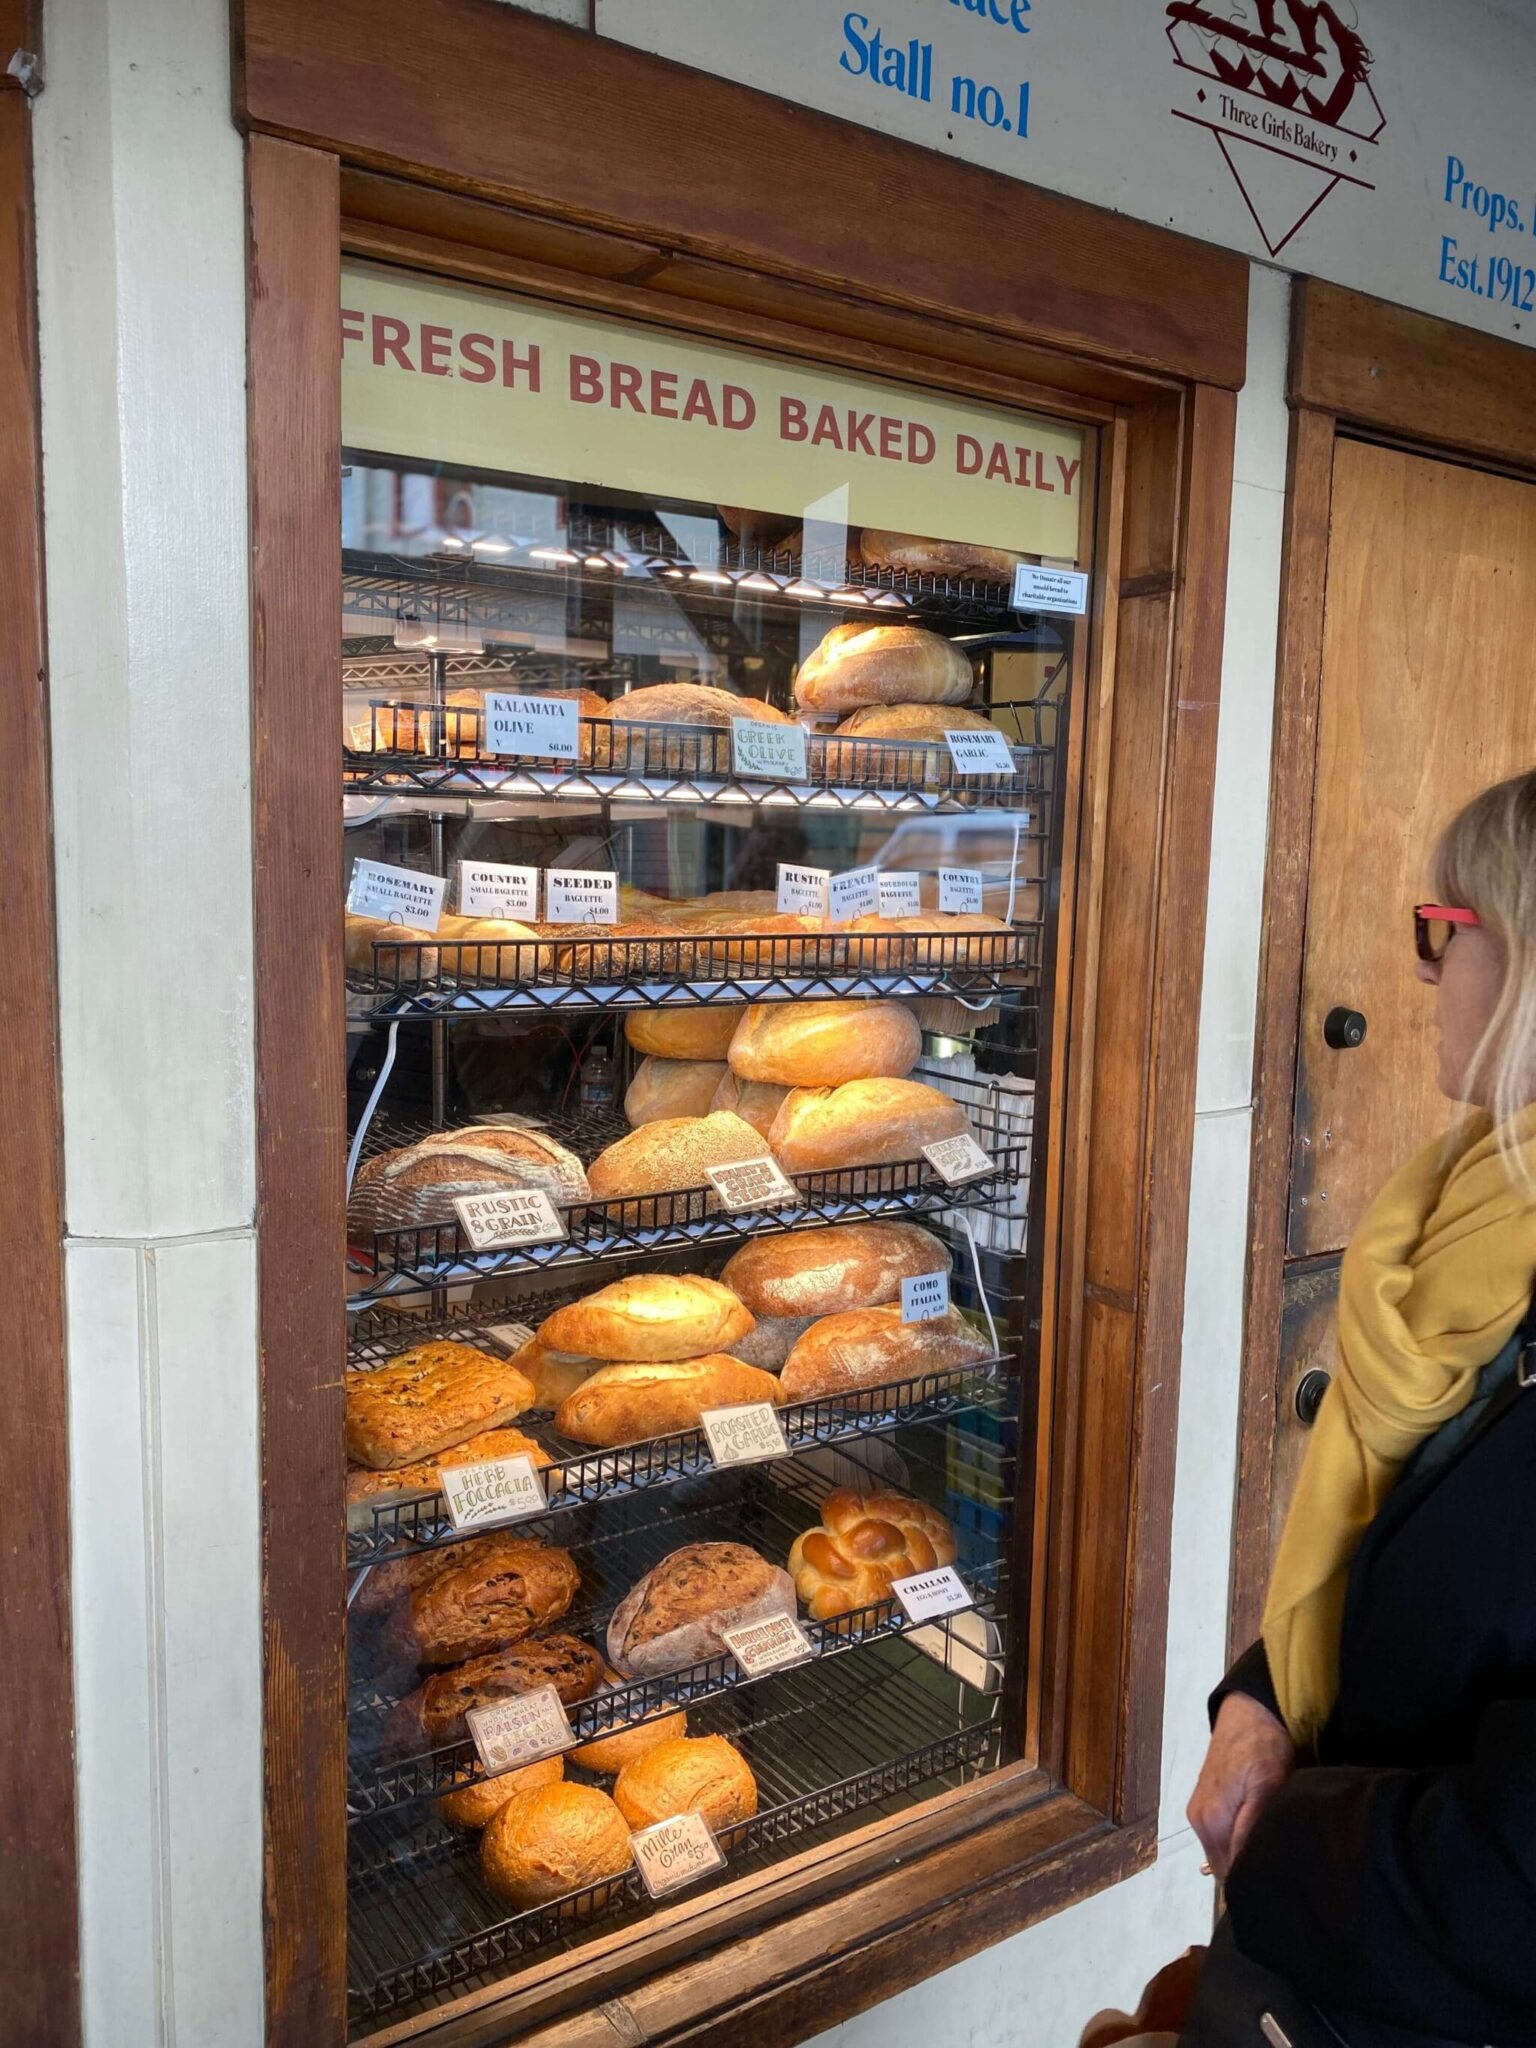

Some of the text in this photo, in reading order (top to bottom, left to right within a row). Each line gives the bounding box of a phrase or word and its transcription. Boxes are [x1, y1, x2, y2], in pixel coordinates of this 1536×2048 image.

[839, 12, 932, 103] Stall
[1219, 93, 1338, 160] Three Girls Bakery
[1444, 155, 1524, 232] Props.
[341, 308, 1080, 496] FRESH BREAD BAKED DAILY
[494, 699, 565, 717] KALAMATA
[494, 720, 534, 734] OLIVE
[737, 729, 786, 744] GREEK
[950, 734, 996, 744] ROSEMARY
[496, 739, 572, 752] V $6.00
[748, 745, 795, 761] OLIVE
[956, 749, 988, 758] GARLIC
[368, 872, 436, 895] ROSEMARY
[471, 873, 528, 885] COUNTRY
[553, 878, 612, 890] SEEDED
[785, 872, 825, 886] RUSTIC
[833, 873, 875, 892] FRENCH
[943, 873, 980, 885] COUNTRY
[366, 885, 432, 906] SMALL BAGUETTE
[470, 886, 529, 897] SMALL BAGUETTE
[791, 888, 819, 897] BAGUETTE
[842, 890, 868, 902] BAGUETTE
[881, 890, 912, 898] BAGUETTE
[950, 886, 974, 894] BAGUETTE
[564, 895, 603, 903] BAGUETTE
[405, 905, 429, 917] $3.00
[727, 1185, 771, 1205] SEED
[465, 1196, 542, 1218] RUSTIC
[470, 1212, 543, 1233] 8 GRAIN
[914, 1279, 938, 1292] COMO
[911, 1294, 941, 1306] ITALIAN
[710, 1407, 769, 1443] ROASTED
[732, 1422, 778, 1450] GARLIC
[461, 1466, 506, 1490] HERB
[453, 1476, 532, 1514] FOCCACIA
[903, 1575, 951, 1594] CHALLAH
[490, 1702, 524, 1717] ORGANIC
[483, 1710, 541, 1740] RAISIN
[502, 1718, 554, 1748] PECAN
[641, 1827, 682, 1862] Mille
[660, 1838, 693, 1868] Gran
